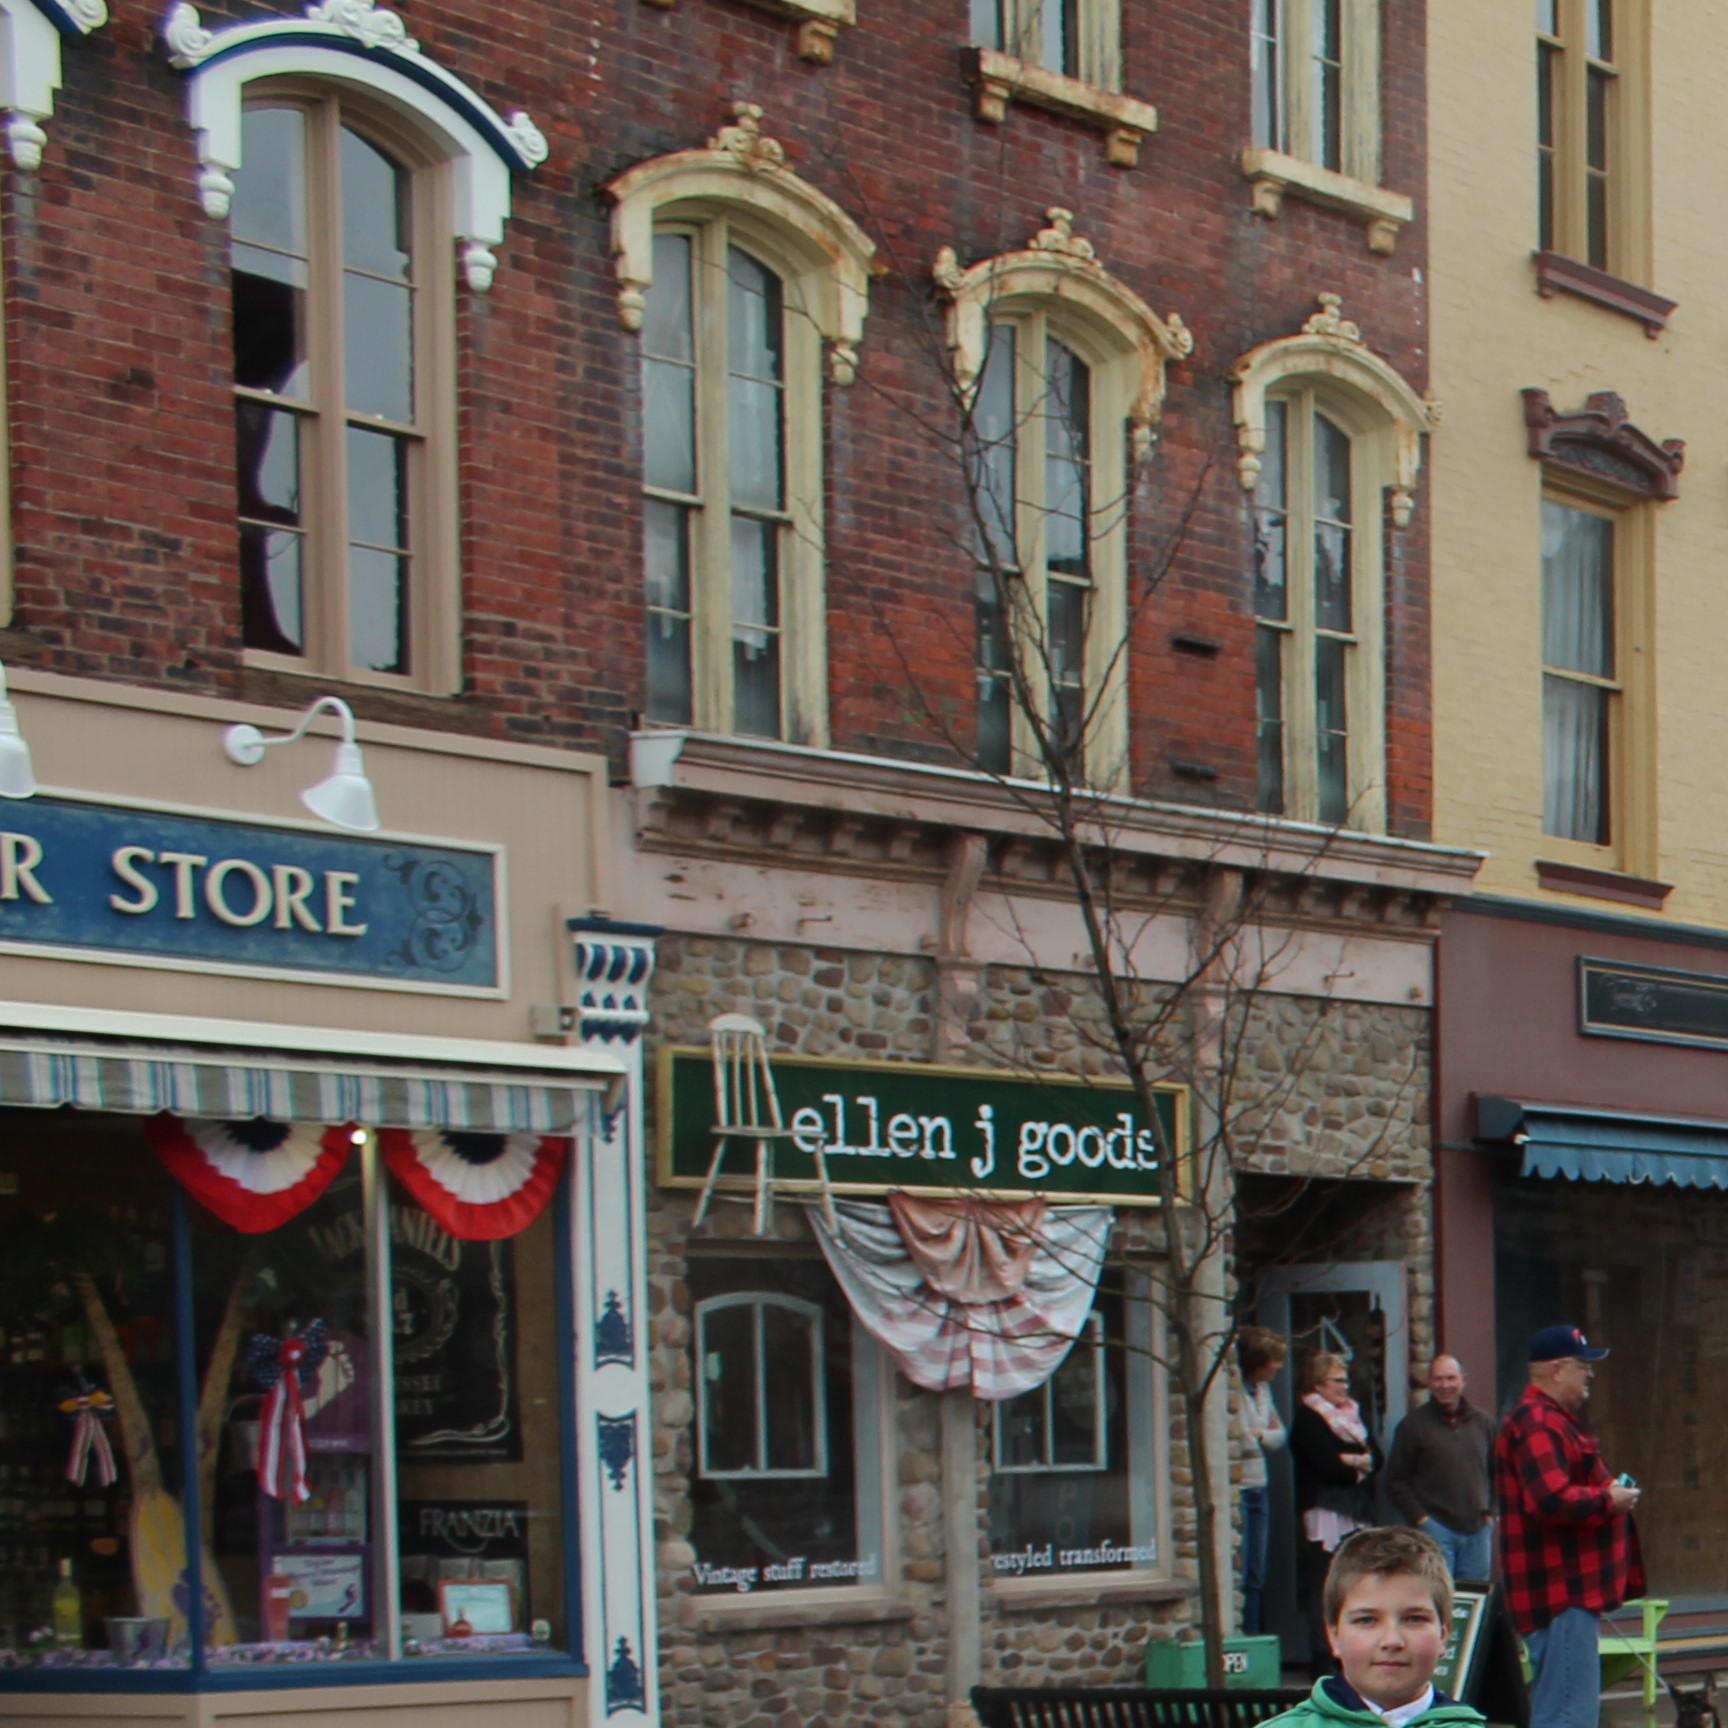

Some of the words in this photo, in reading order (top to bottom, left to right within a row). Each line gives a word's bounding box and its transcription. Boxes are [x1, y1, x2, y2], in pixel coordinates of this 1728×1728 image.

[109, 844, 369, 937] STORE
[792, 1093, 954, 1160] ellen
[970, 1103, 996, 1178] j
[1017, 1112, 1160, 1180] goods
[419, 1508, 520, 1540] FRANZIA
[1058, 1537, 1158, 1567] transformed
[692, 1562, 759, 1593] Vintage
[763, 1558, 805, 1582] stuff
[809, 1555, 877, 1582] restored
